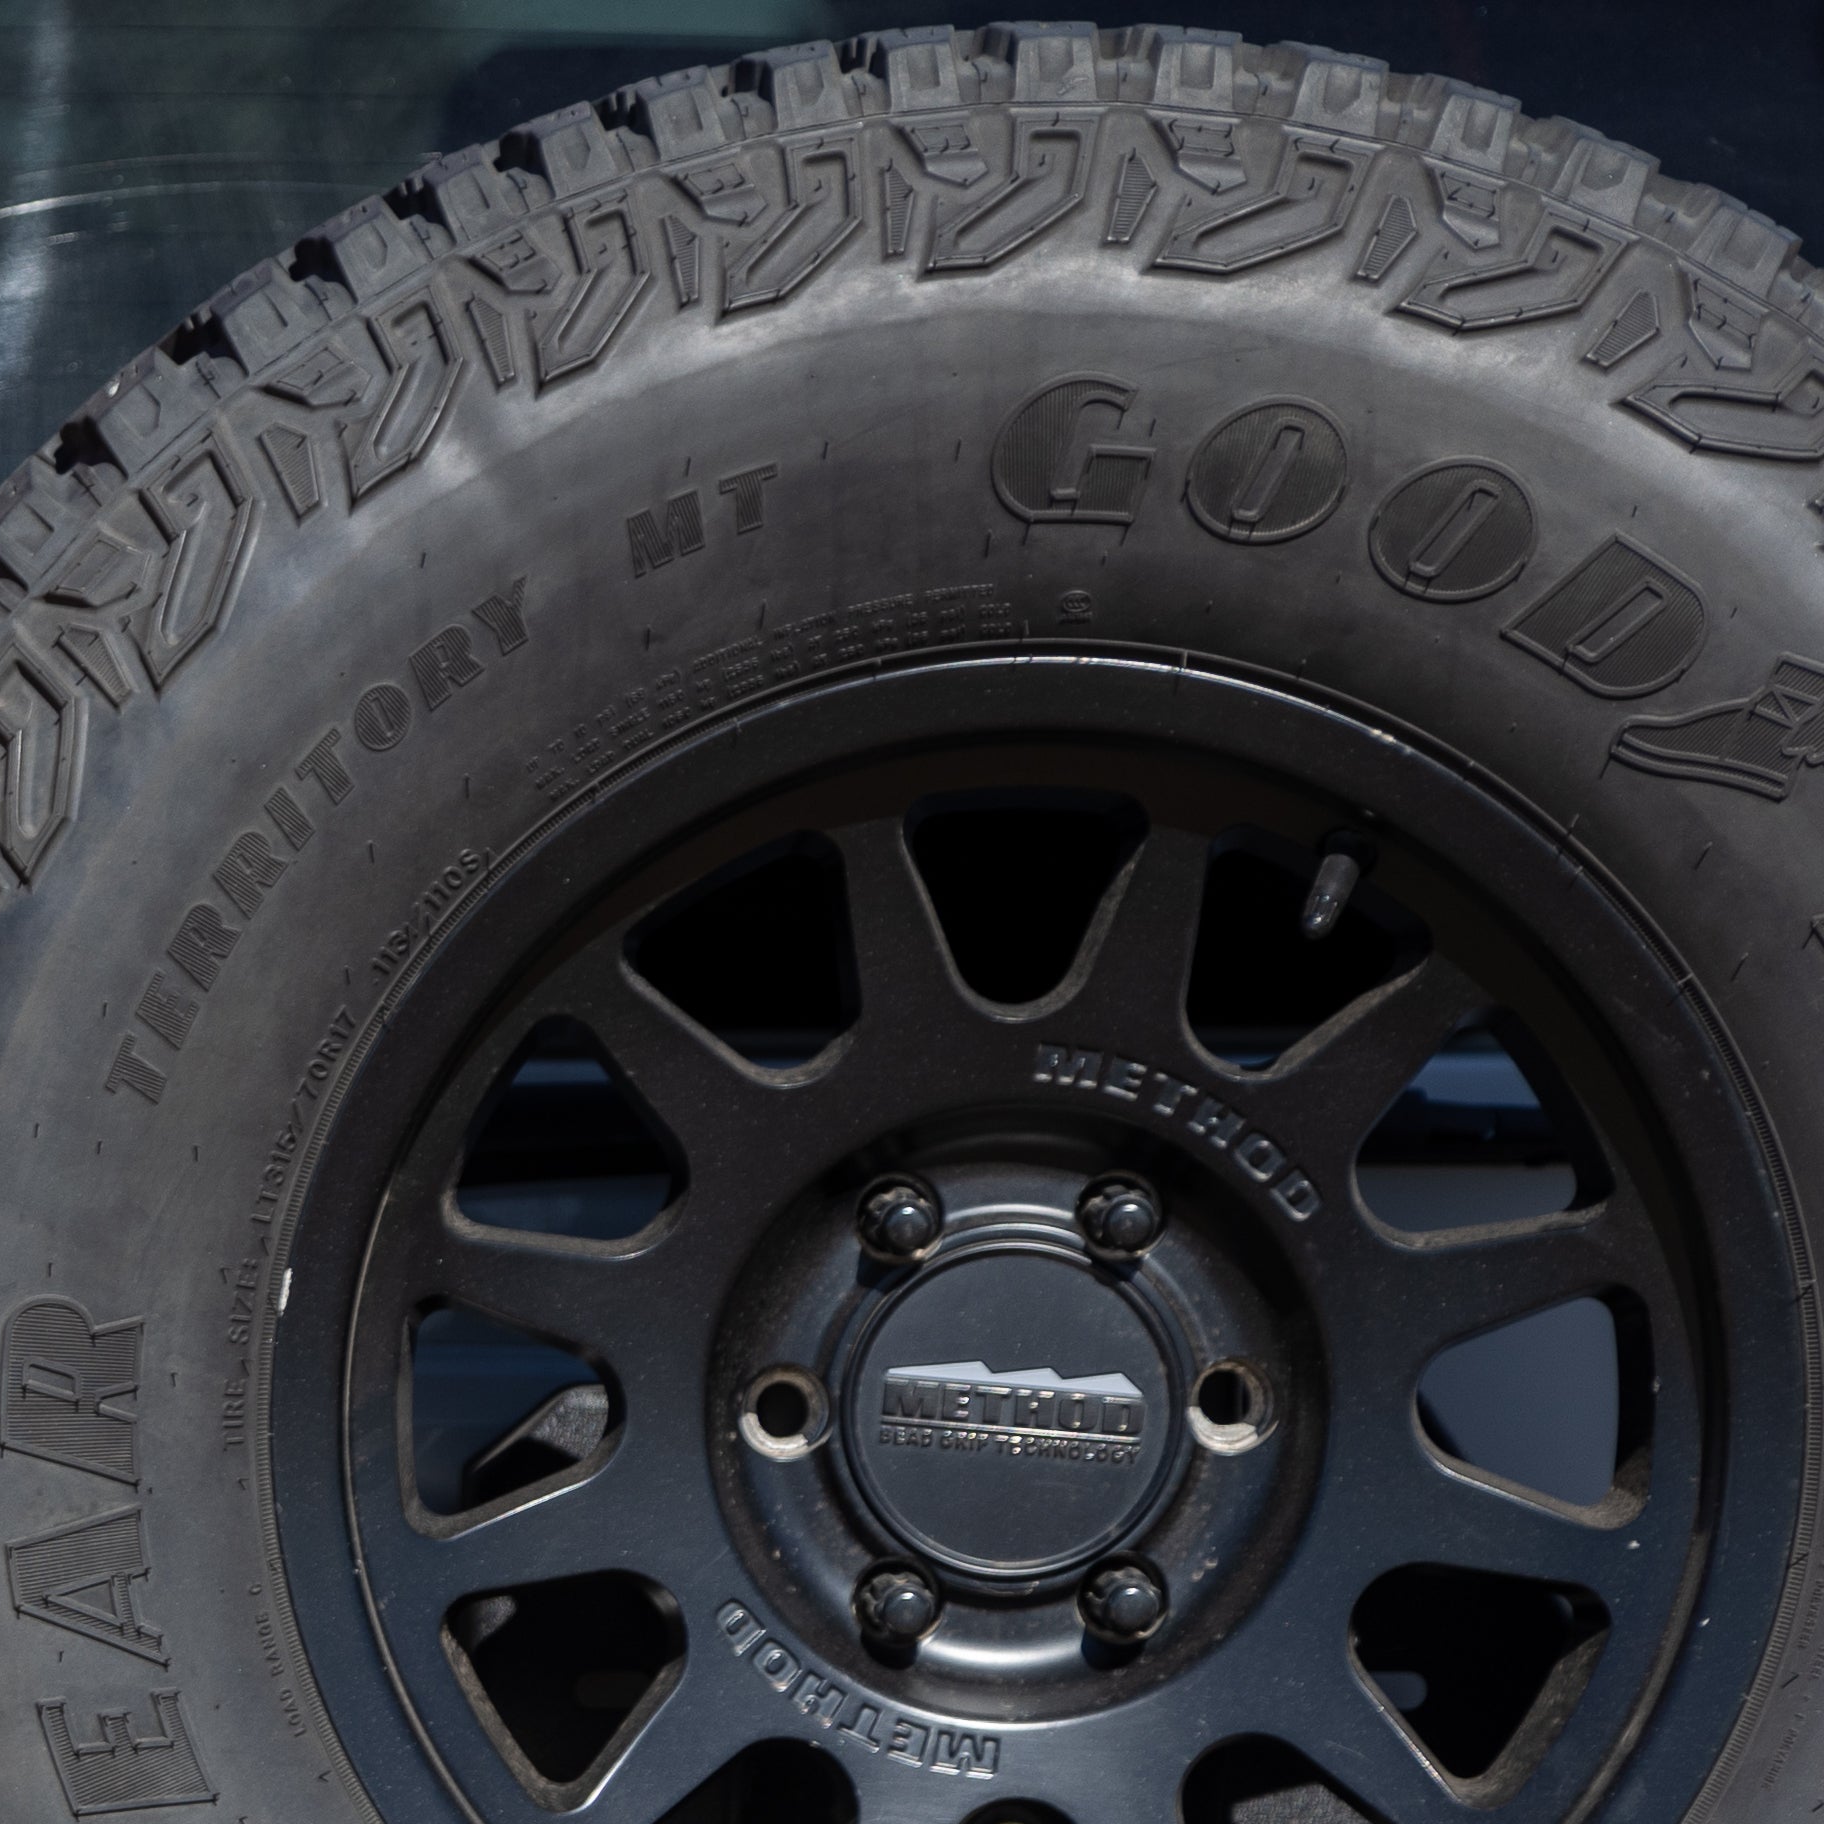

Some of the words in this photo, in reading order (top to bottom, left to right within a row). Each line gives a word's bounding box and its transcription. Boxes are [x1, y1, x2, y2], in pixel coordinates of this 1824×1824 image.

[105, 575, 531, 1106] TERRITORY
[623, 462, 779, 578] MT
[1032, 1042, 1325, 1223] METHOD
[223, 1377, 247, 1450] TIRE
[251, 1009, 358, 1227] LT315/70R17
[879, 1427, 936, 1450] BEAD
[940, 1430, 988, 1454] GRIP
[991, 1434, 1142, 1467] TECHNOLOGY
[880, 1380, 1145, 1436] METHOD
[716, 1599, 1001, 1781] METHOD
